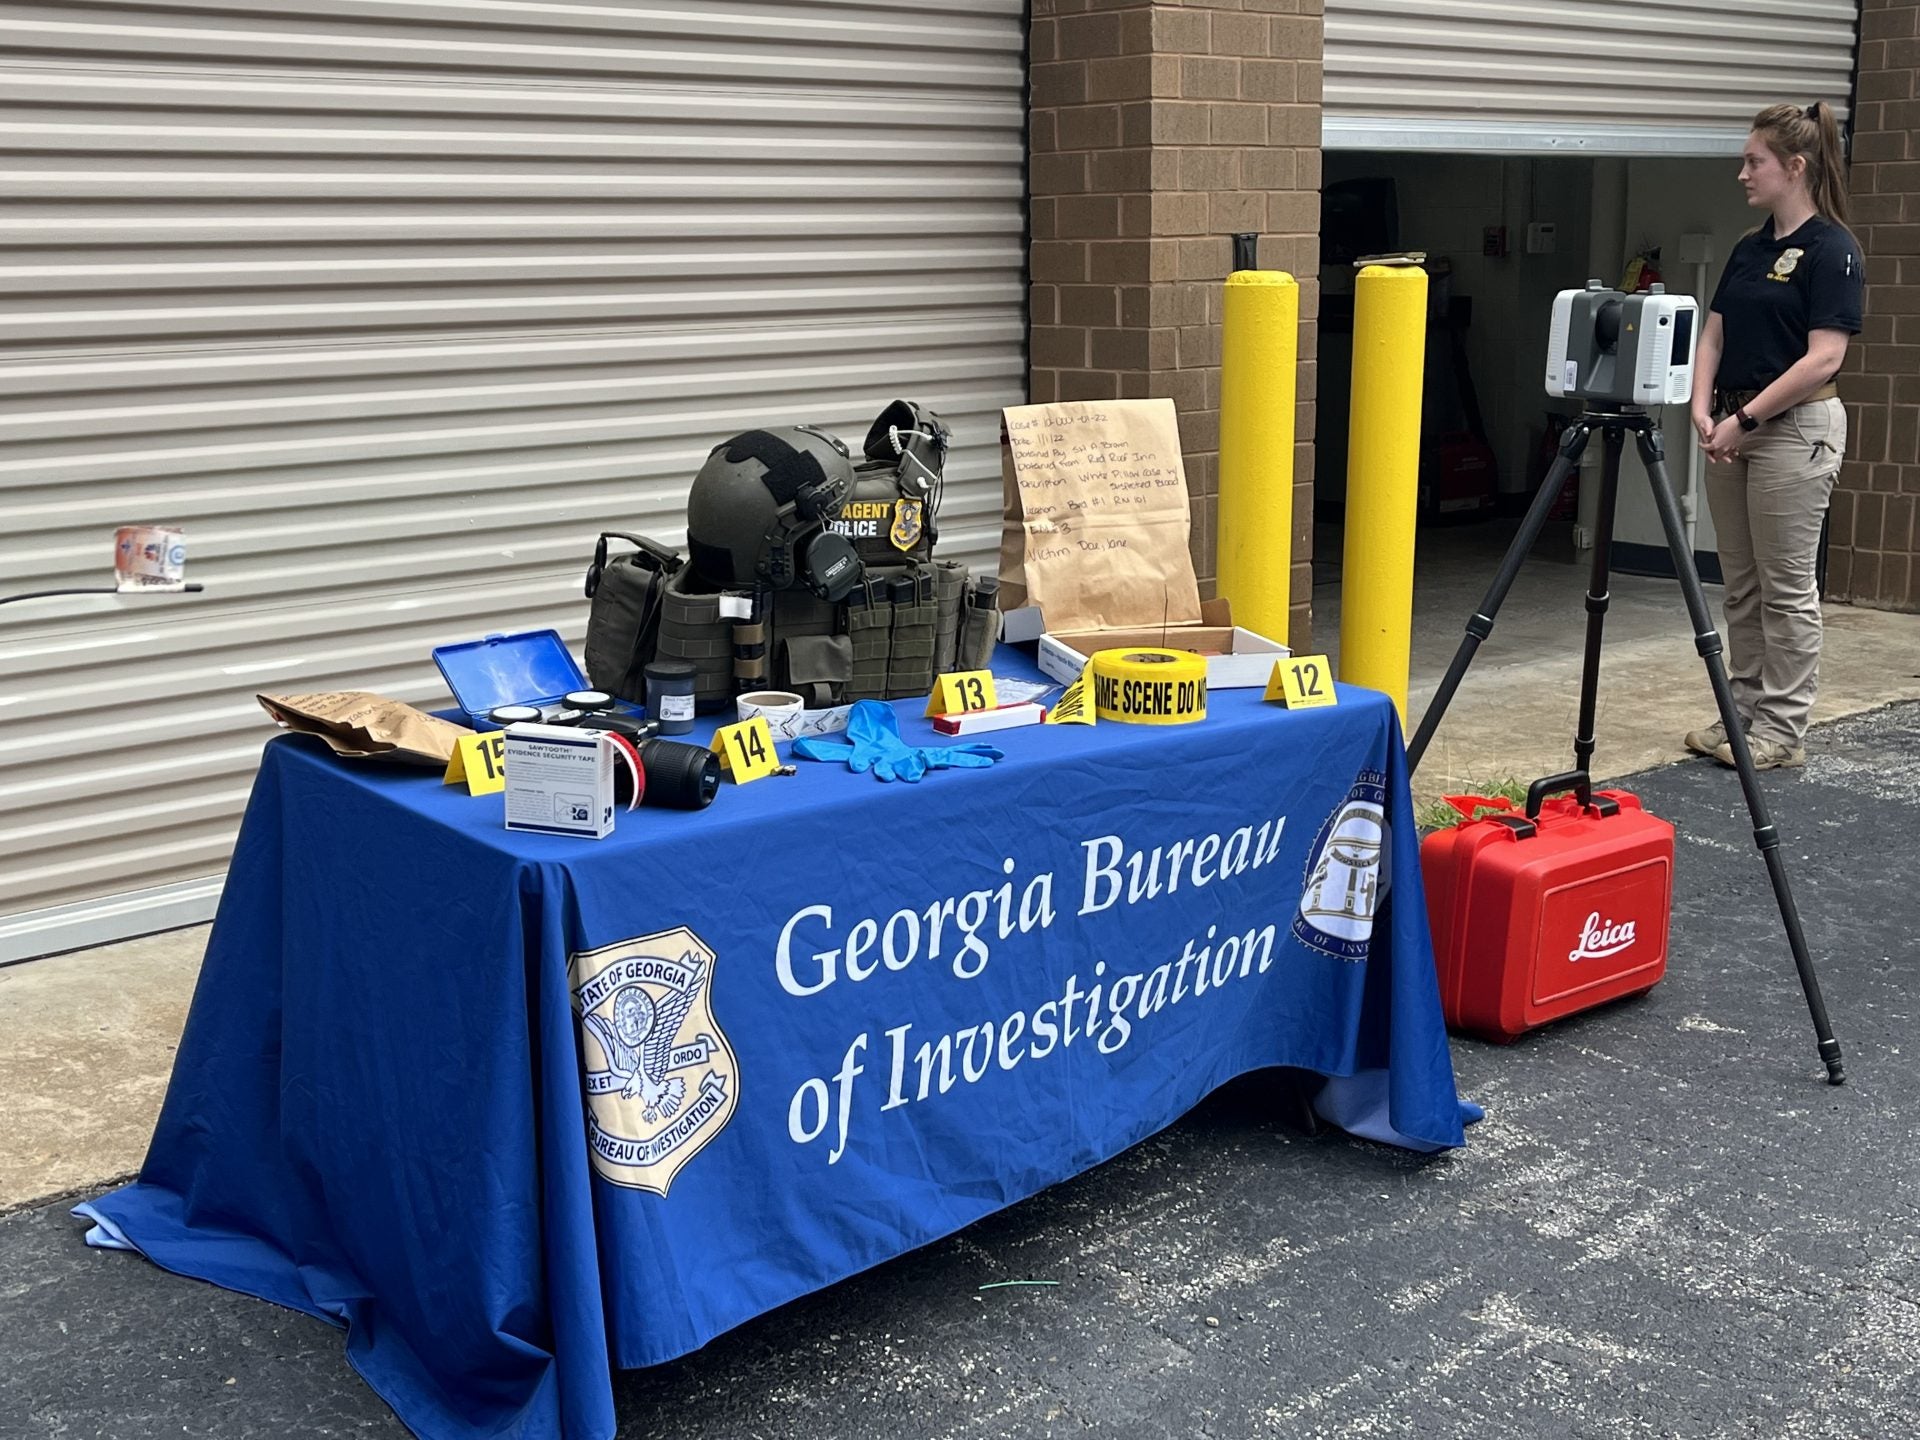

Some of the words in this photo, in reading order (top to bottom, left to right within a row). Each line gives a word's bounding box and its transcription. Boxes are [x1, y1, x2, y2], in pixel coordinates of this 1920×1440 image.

[1088, 454, 1105, 463] Red
[1109, 452, 1128, 462] Roof
[1132, 452, 1156, 461] Inn
[841, 503, 890, 518] AGENT
[1028, 547, 1071, 562] Victim
[955, 677, 986, 712] 13
[1291, 663, 1324, 698] 12
[1122, 679, 1172, 715] SCENE
[1177, 680, 1195, 714] DO
[507, 748, 541, 758] EVIDENCE
[543, 752, 577, 761] SECURITY
[578, 755, 596, 763] TAPE
[733, 725, 766, 768] 14
[1351, 787, 1366, 799] OF
[775, 857, 1056, 996] Georgia
[1078, 815, 1286, 916] Bureau
[1568, 911, 1636, 962] Leica
[609, 966, 623, 986] OF
[626, 962, 687, 988] GEORGIA
[673, 1048, 702, 1065] ORDO
[788, 1033, 868, 1165] of
[880, 924, 1276, 1112] Investigation
[600, 1076, 612, 1088] ET
[590, 1124, 635, 1160] BUREAU
[637, 1145, 651, 1161] OF
[651, 1091, 719, 1160] INVESTIGATION
